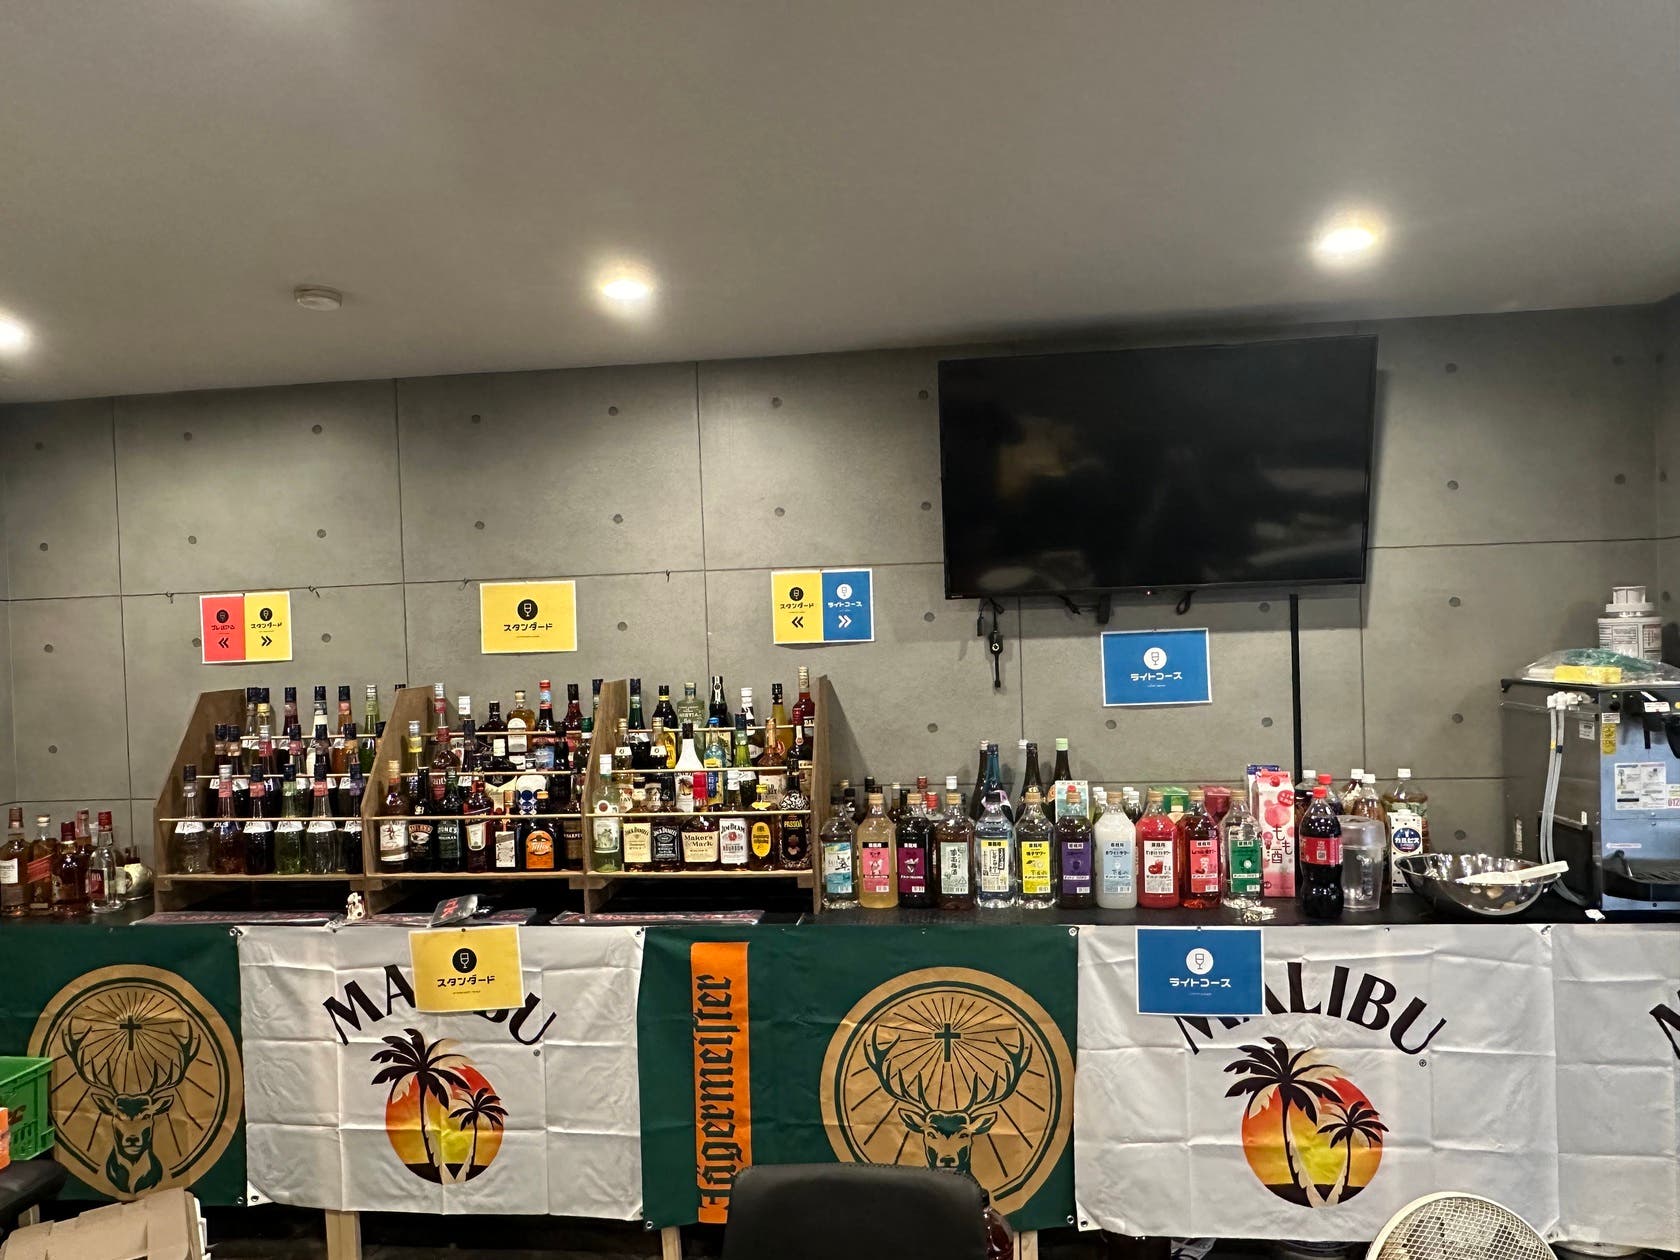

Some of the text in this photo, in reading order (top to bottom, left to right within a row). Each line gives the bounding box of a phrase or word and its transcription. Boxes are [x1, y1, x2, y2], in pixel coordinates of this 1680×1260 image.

[503, 622, 553, 632] スタンダード
[1130, 671, 1183, 682] ライトコース
[437, 974, 496, 987] スタンダード
[1169, 978, 1232, 988] ライトコース
[323, 964, 557, 1046] MAU
